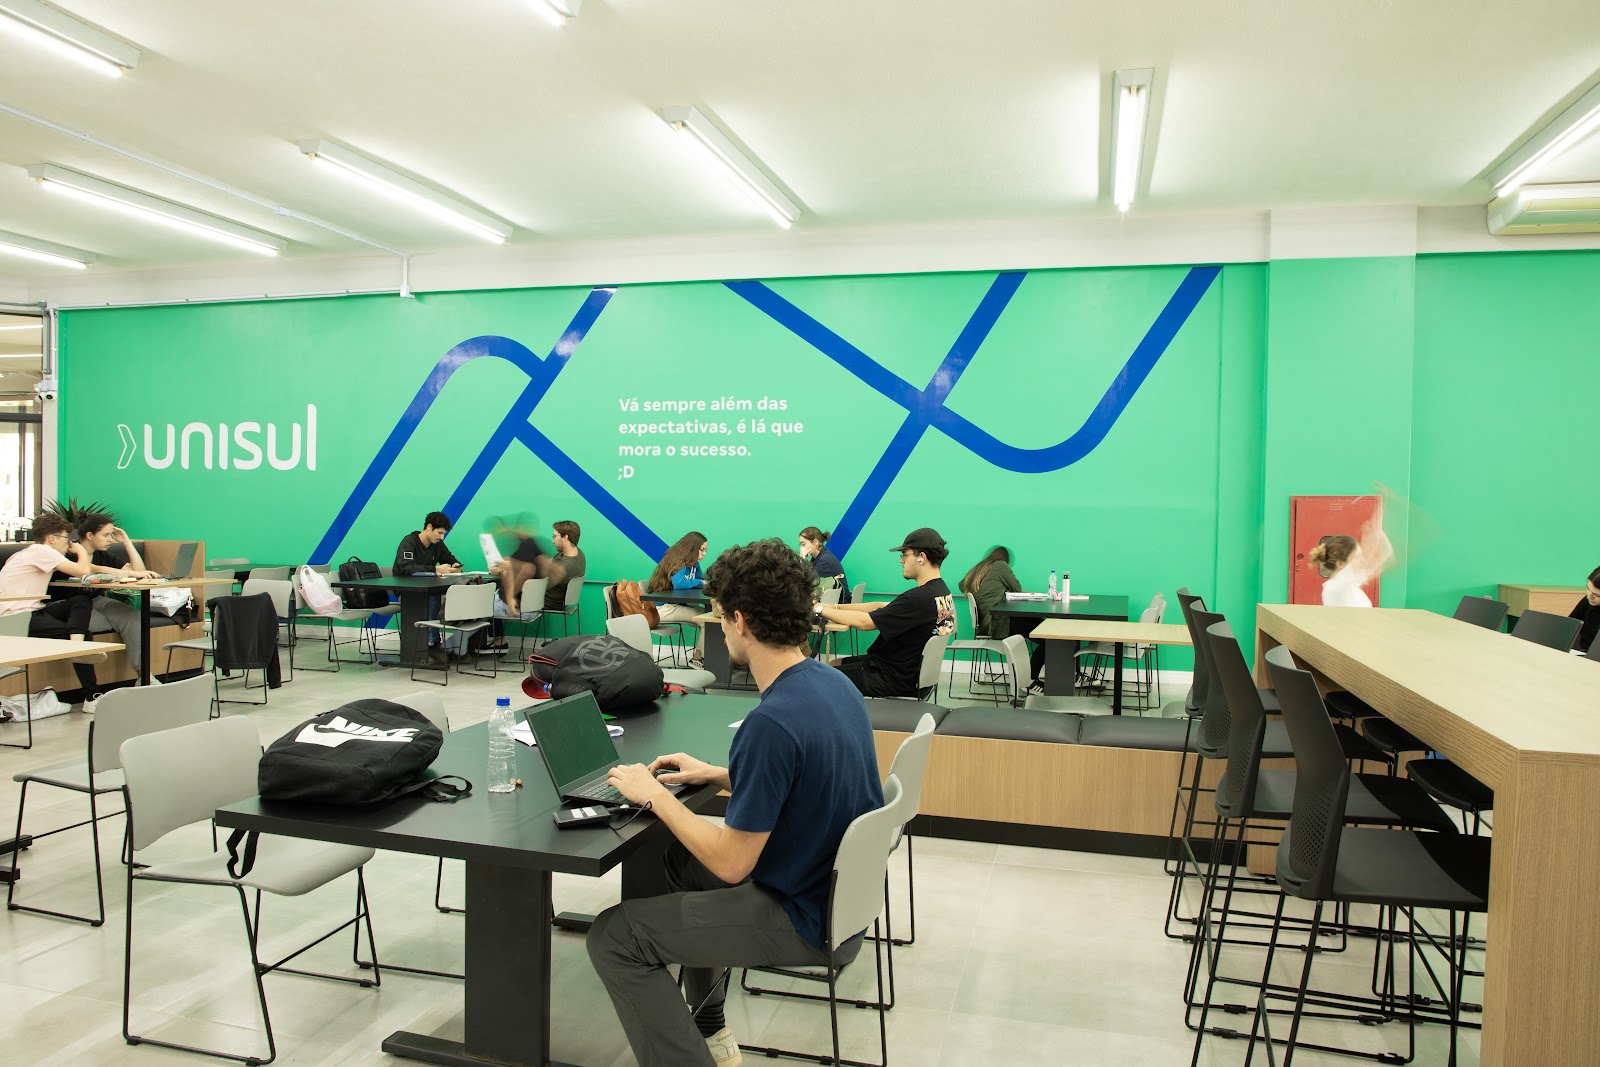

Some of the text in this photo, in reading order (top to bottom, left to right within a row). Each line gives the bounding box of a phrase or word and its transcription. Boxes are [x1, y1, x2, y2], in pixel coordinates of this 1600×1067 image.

[618, 395, 788, 415] Vá sempre além das
[618, 418, 804, 437] expectativas, é lá que
[618, 444, 752, 457] mora o sucesso.
[617, 465, 635, 481] ;D
[317, 715, 420, 738] NIKE
